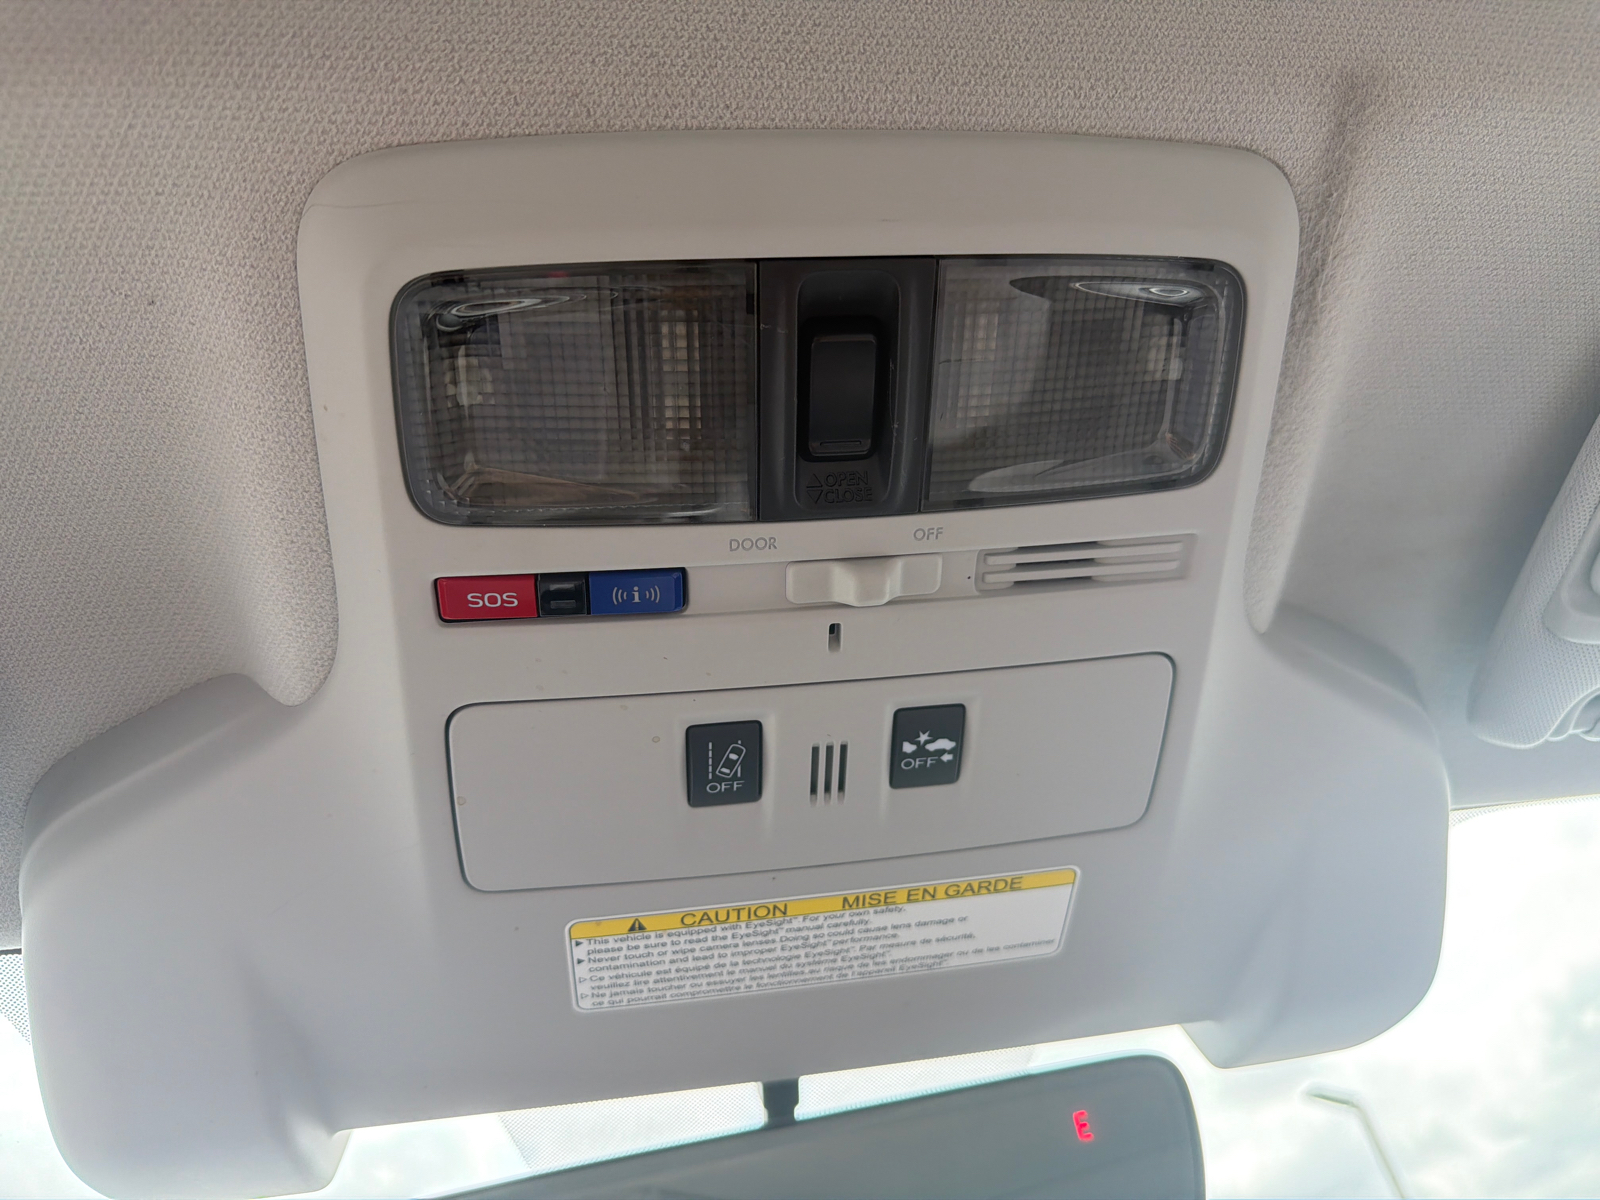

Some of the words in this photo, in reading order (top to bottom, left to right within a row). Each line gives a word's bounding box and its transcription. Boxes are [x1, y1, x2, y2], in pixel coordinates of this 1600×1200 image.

[824, 471, 869, 487] OPEN
[824, 487, 873, 503] CLOSE
[913, 527, 944, 541] OFF
[729, 537, 777, 552] DOOR
[467, 592, 519, 608] SOS
[901, 757, 938, 770] OFF
[706, 781, 745, 794] OFF
[842, 891, 897, 909] MISE
[906, 886, 937, 902] EN
[944, 877, 1022, 897] GARDE
[680, 903, 788, 926] CAUTION
[613, 933, 652, 943] vehicle
[667, 926, 717, 938] equipped
[720, 923, 742, 932] with
[823, 912, 846, 921] your
[849, 910, 870, 918] own
[587, 946, 623, 956] please
[644, 941, 668, 949] sure
[684, 936, 708, 945] read
[785, 923, 824, 933] manual
[588, 955, 621, 964] Never
[624, 951, 654, 960] touch
[672, 946, 696, 955] wipe
[699, 942, 740, 952] camera
[827, 929, 854, 937] could
[589, 959, 666, 973] contamination
[669, 956, 689, 964] and
[692, 953, 715, 962] lead
[1073, 1110, 1094, 1142] E
